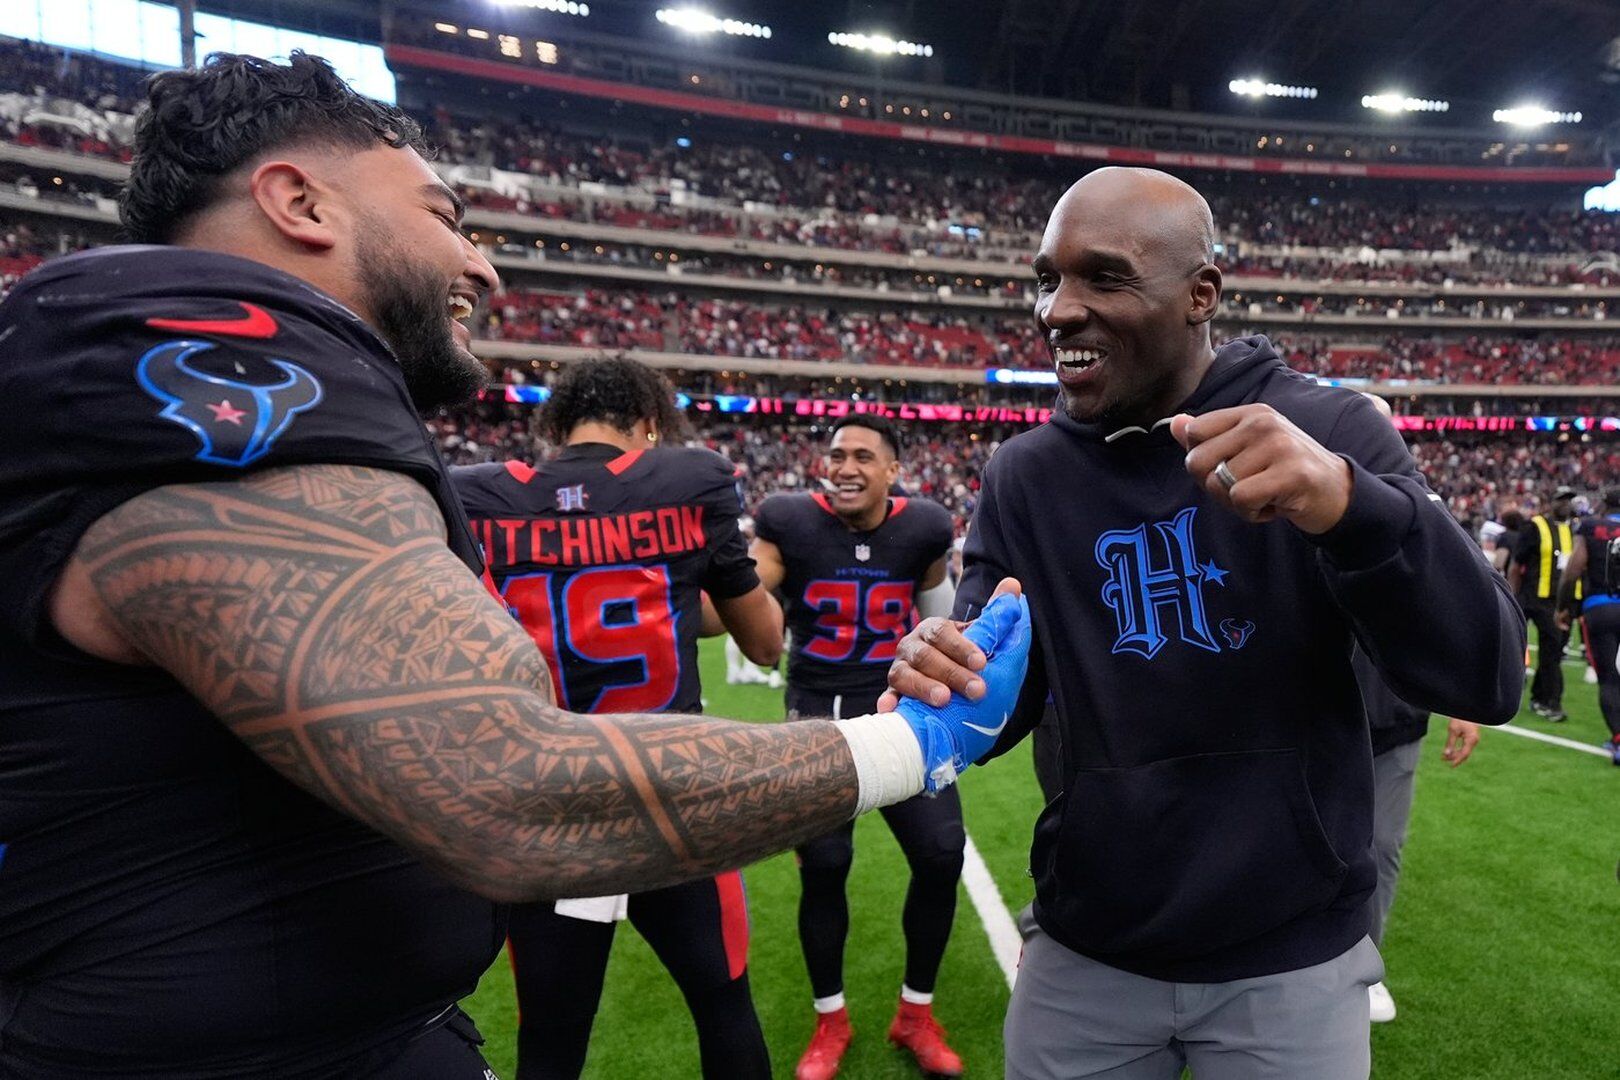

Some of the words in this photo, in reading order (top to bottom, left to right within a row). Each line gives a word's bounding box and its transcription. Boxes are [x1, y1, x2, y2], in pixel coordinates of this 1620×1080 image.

[470, 505, 706, 566] UTCHINSON
[500, 564, 680, 714] 19
[802, 579, 914, 664] 39
